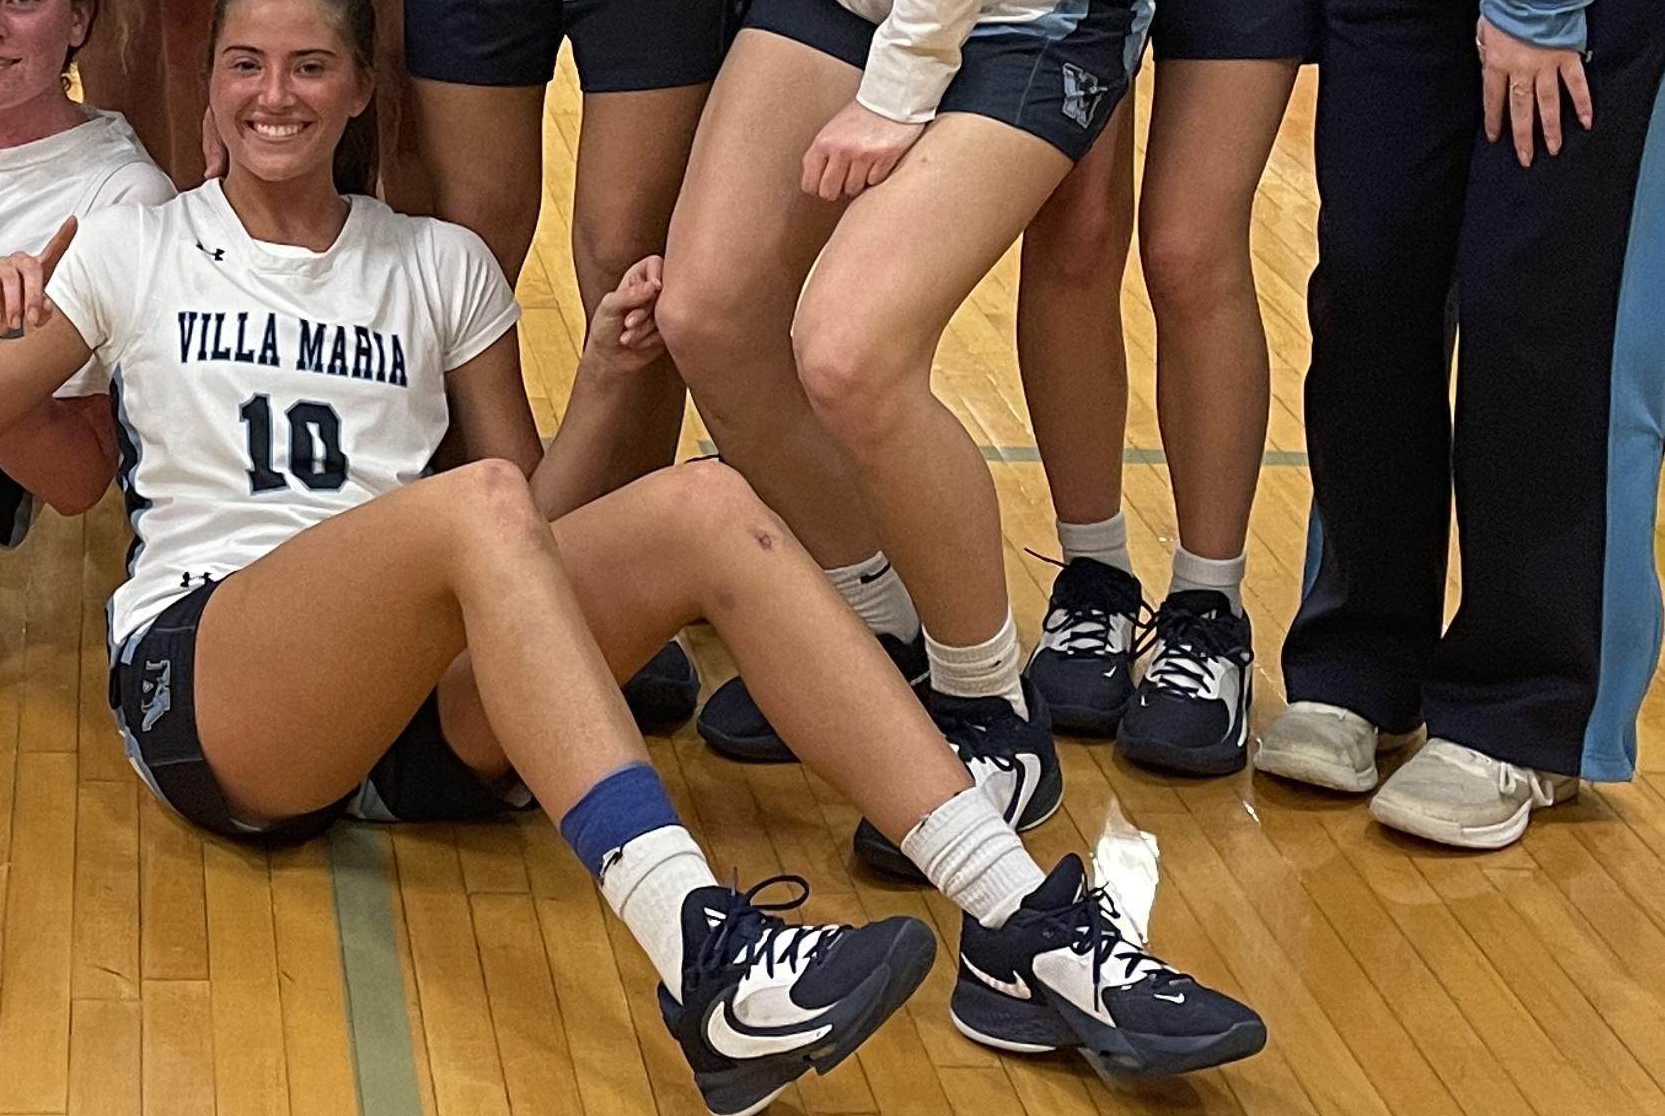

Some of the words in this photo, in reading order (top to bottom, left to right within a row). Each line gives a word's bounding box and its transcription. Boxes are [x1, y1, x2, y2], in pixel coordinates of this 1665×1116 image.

[178, 311, 281, 368] VILLA
[296, 318, 408, 388] MARIA
[238, 392, 351, 496] 10
